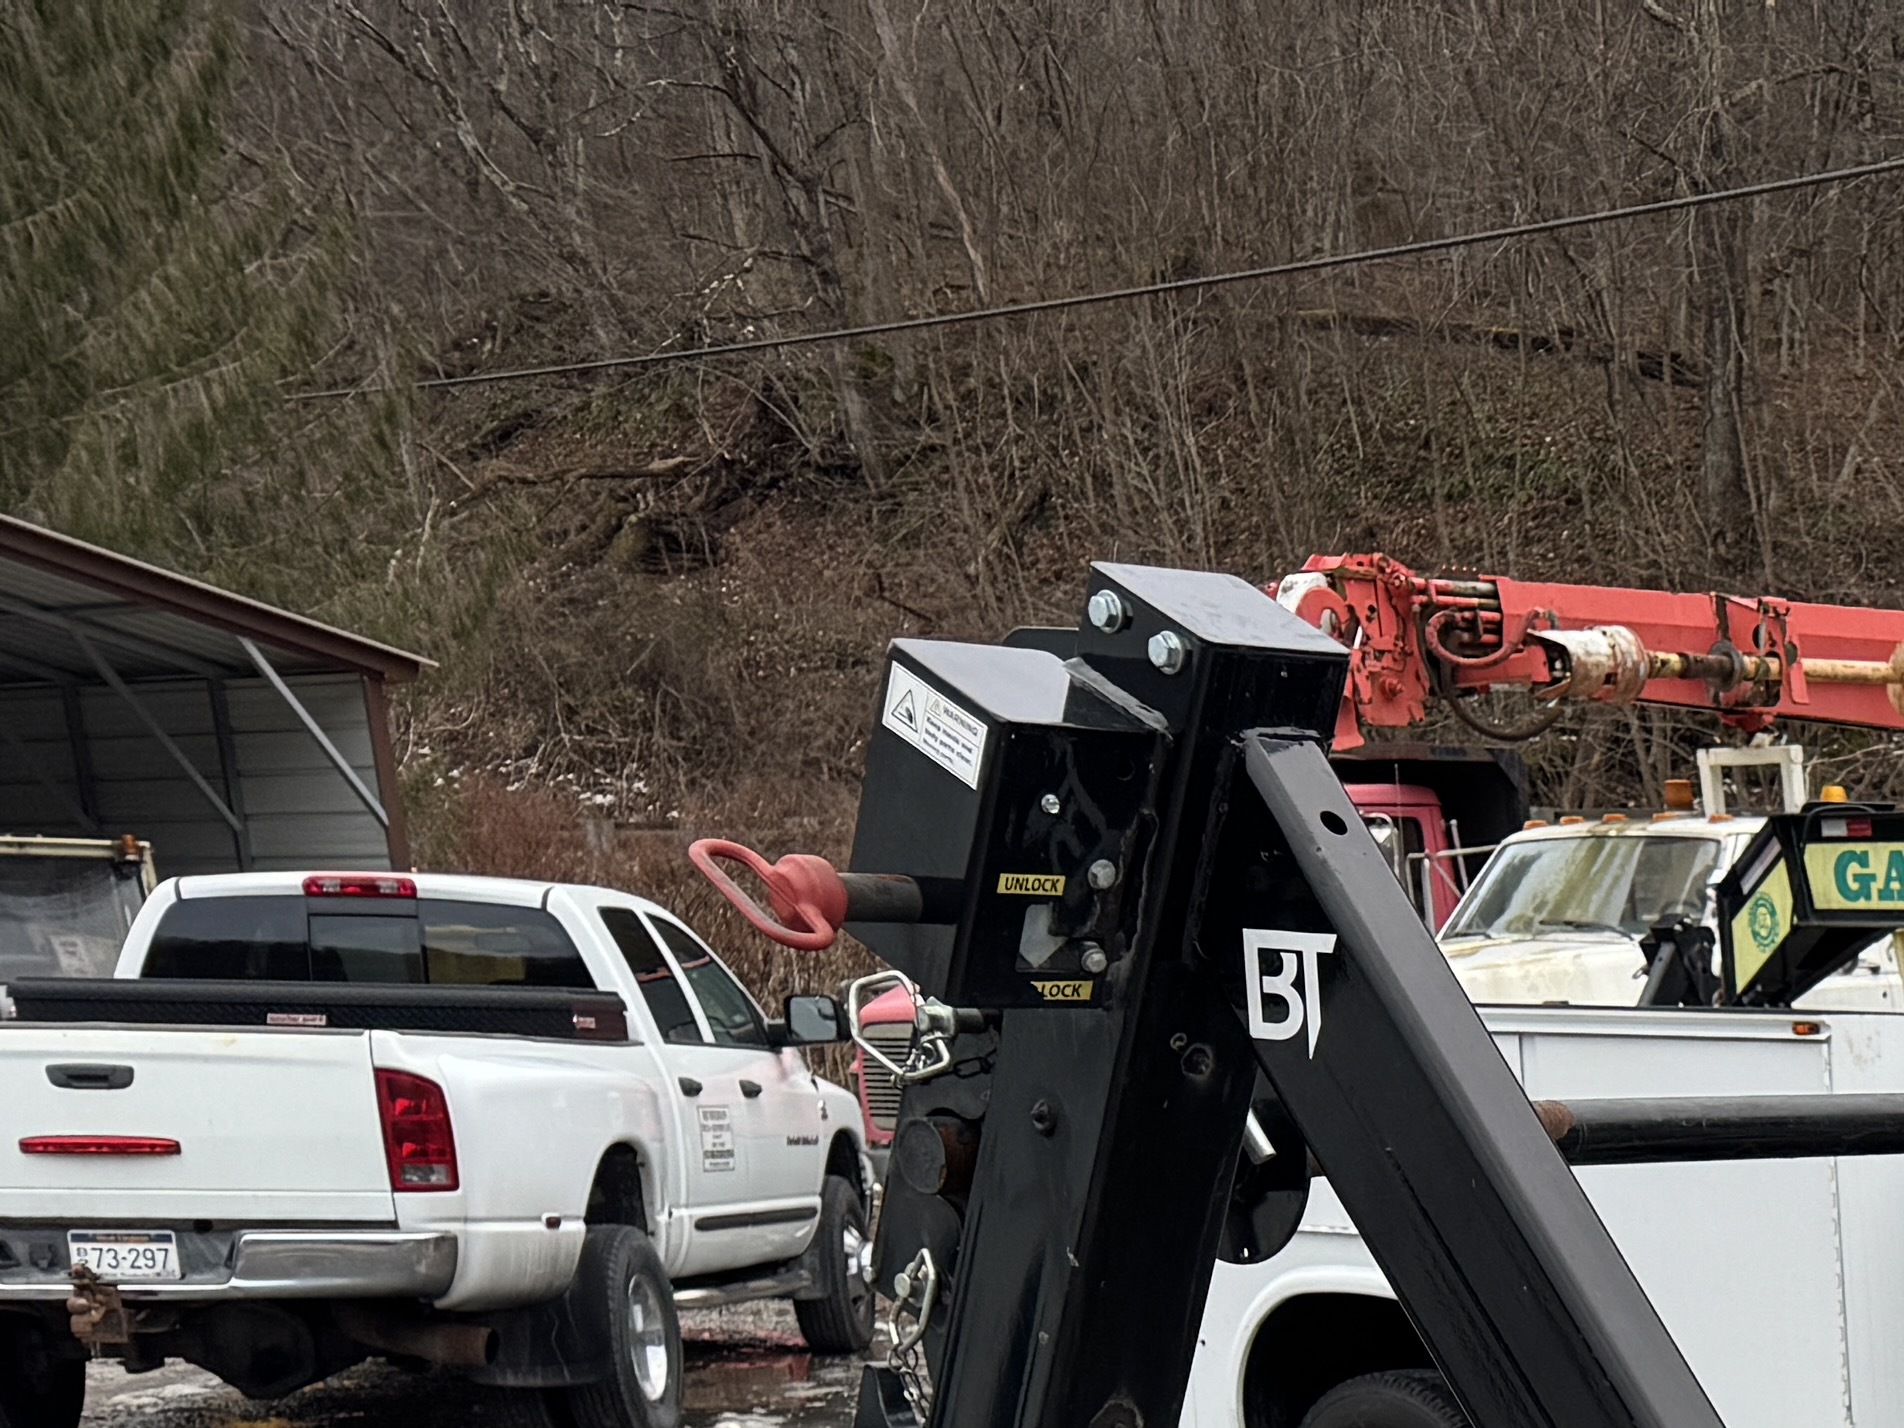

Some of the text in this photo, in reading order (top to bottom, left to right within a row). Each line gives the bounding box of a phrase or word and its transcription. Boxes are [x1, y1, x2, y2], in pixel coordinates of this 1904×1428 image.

[1004, 876, 1060, 892] UNLOCK
[1041, 983, 1083, 998] LOCK
[1242, 928, 1337, 1060] BT
[90, 1247, 169, 1270] 73-297
